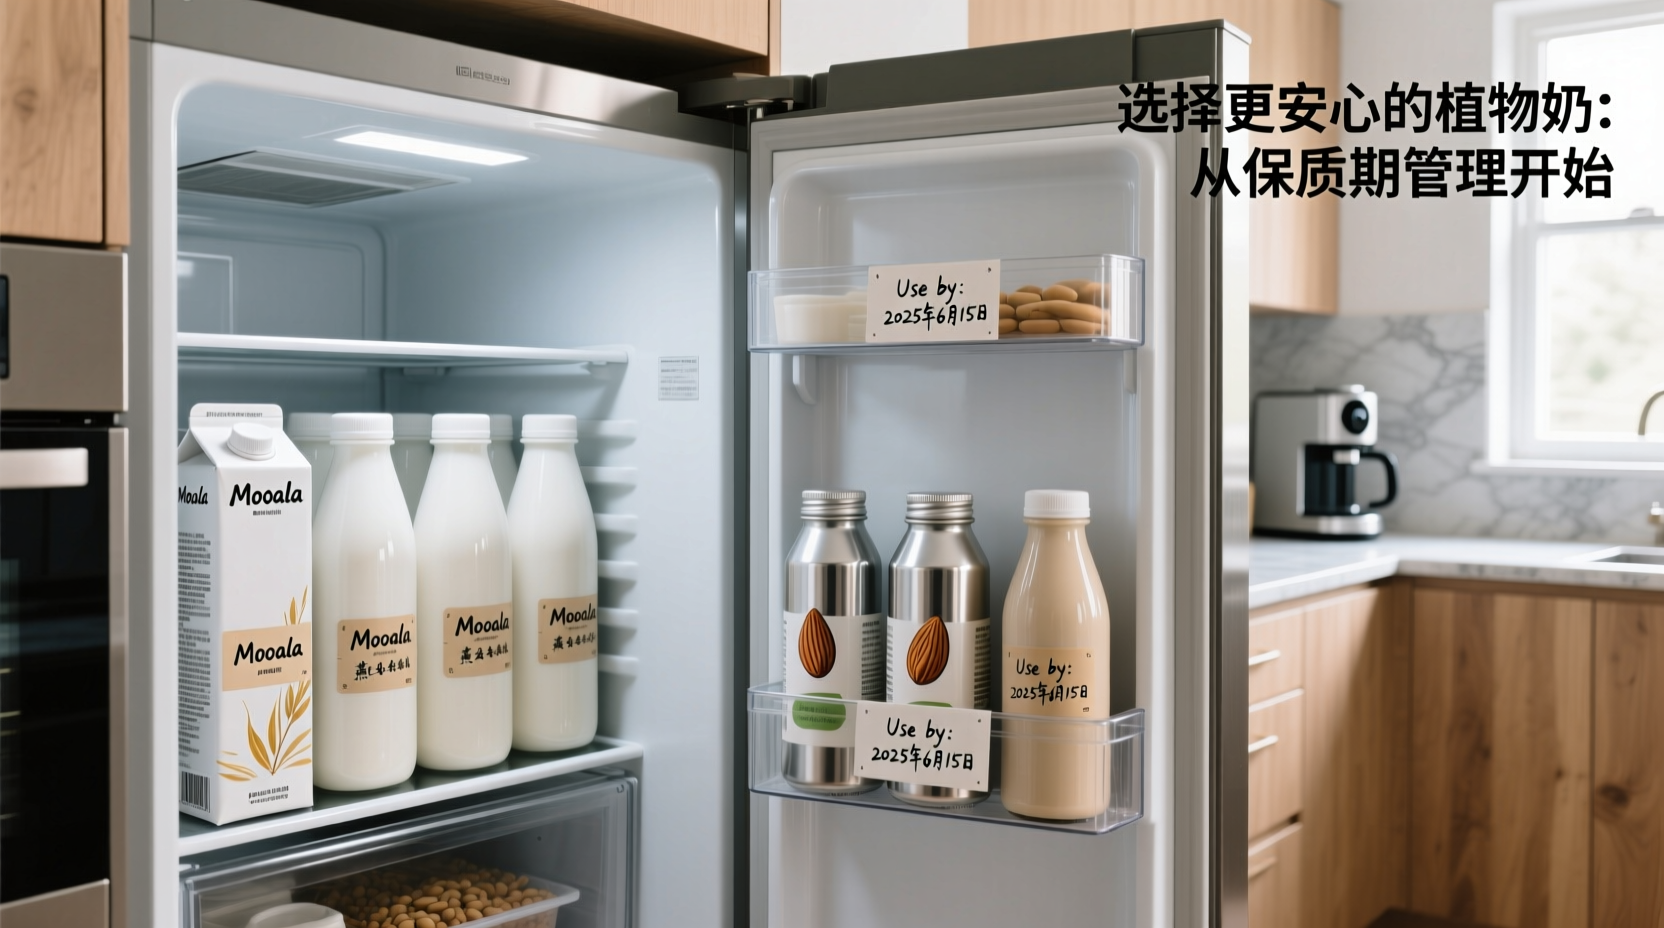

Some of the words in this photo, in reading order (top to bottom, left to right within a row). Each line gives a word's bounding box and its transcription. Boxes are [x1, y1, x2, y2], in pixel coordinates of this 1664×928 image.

[896, 278, 928, 298] Use
[936, 274, 964, 306] by:
[883, 301, 988, 332] 2025年6月15日
[229, 480, 303, 507] Mooala
[455, 610, 510, 637] Mooala
[549, 603, 596, 626] Mooala
[233, 636, 304, 667] Mooala
[350, 622, 412, 652] Mooala
[1016, 658, 1040, 676] Use
[1047, 657, 1072, 684] by:
[887, 717, 916, 738] Use
[925, 718, 953, 749] by:
[871, 742, 974, 773] 2025年6月15日
